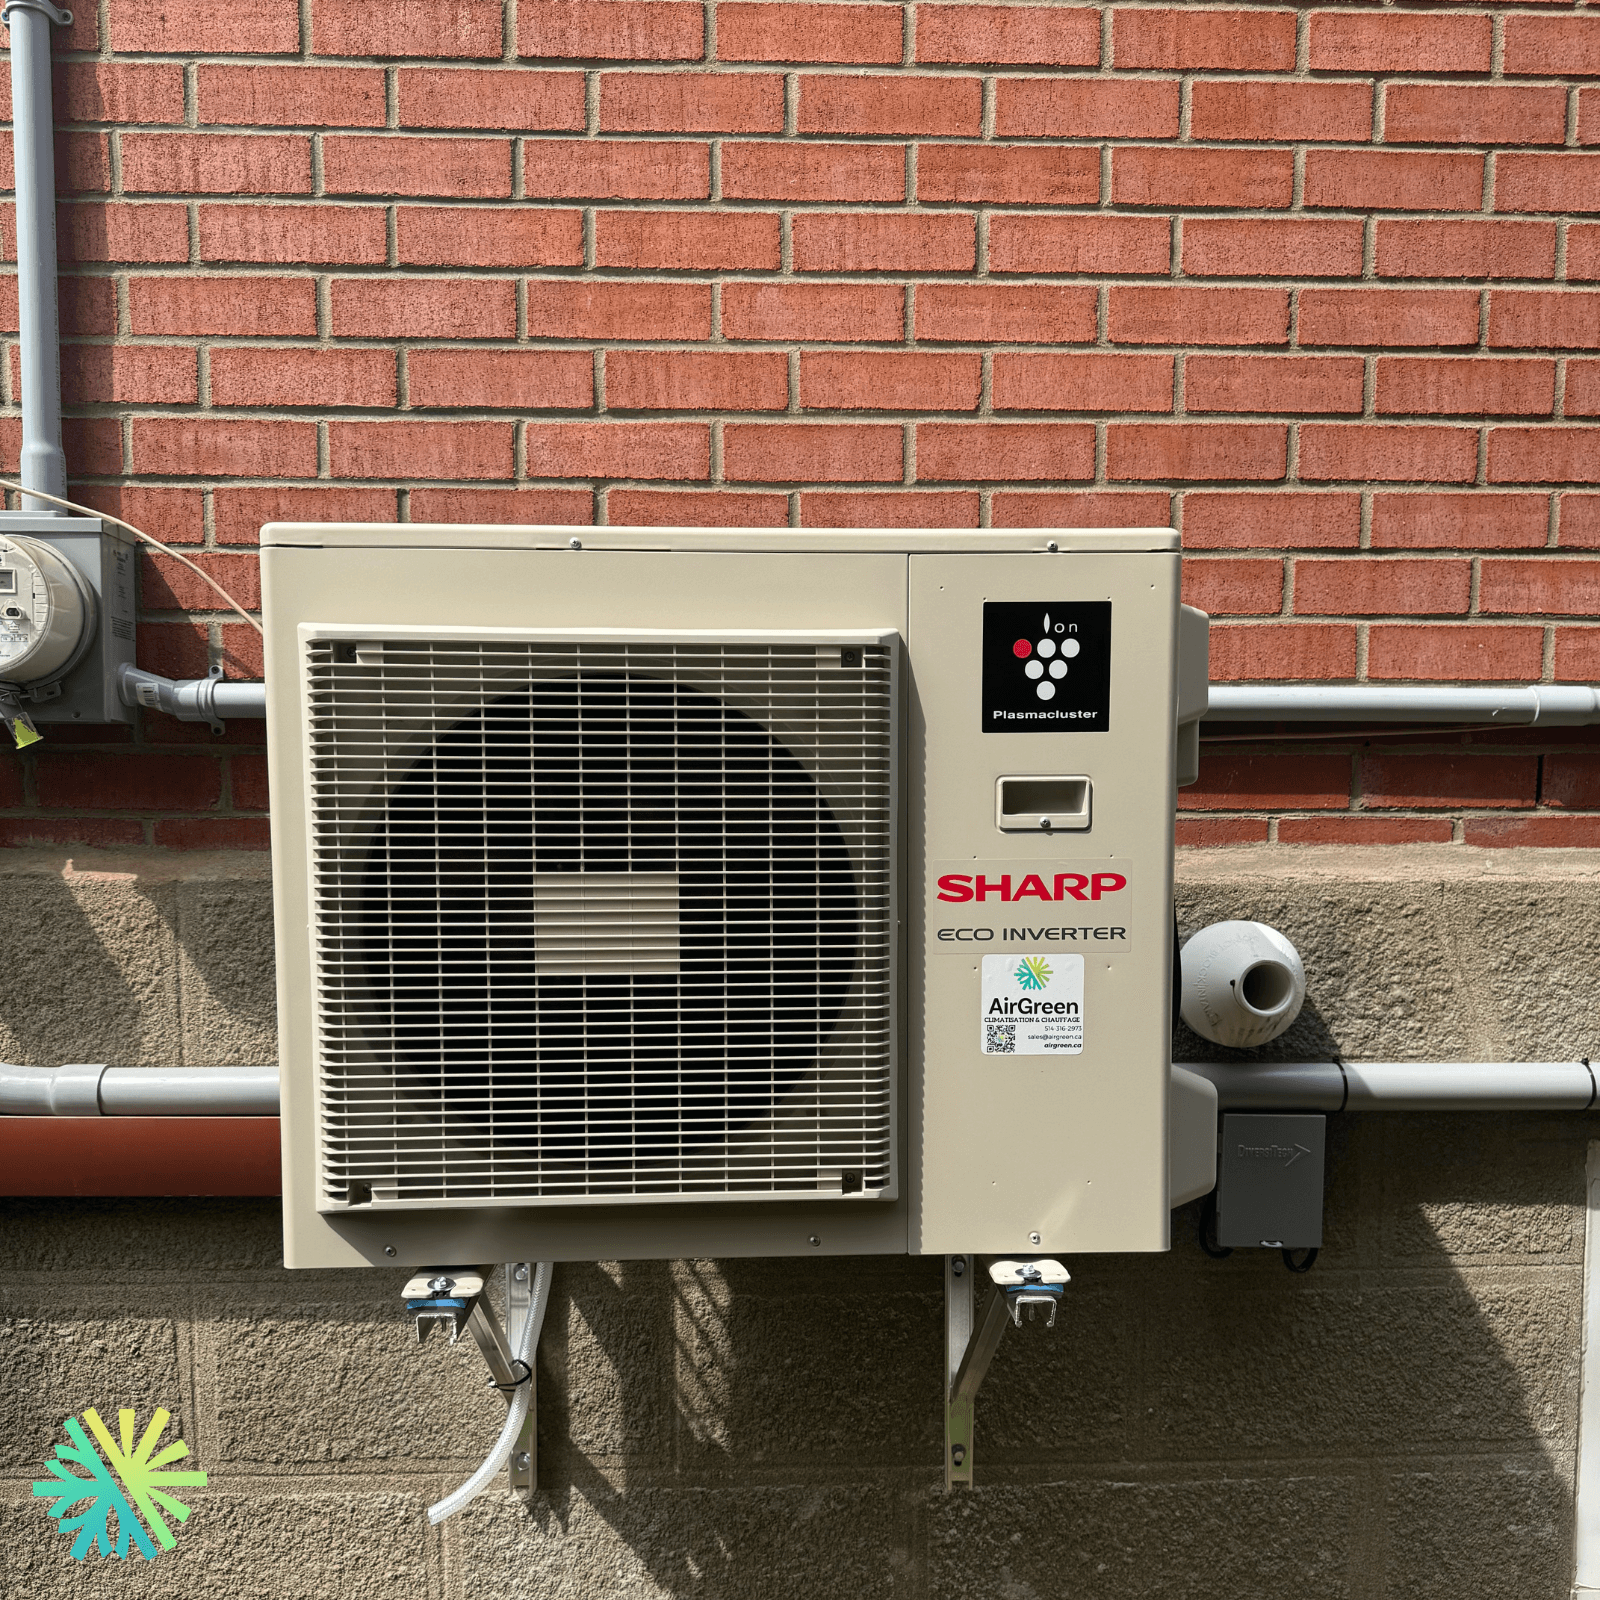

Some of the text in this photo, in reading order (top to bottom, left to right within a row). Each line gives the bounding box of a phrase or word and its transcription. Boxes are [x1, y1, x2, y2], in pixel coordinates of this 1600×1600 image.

[993, 710, 1098, 719] Plasmacluster
[937, 873, 1127, 903] SHARP
[937, 927, 1126, 941] ECO INVERTER
[988, 996, 1079, 1015] AirGreen
[1027, 1033, 1082, 1041] sales@airgreen.ca
[1044, 1042, 1082, 1050] airgreen.ca
